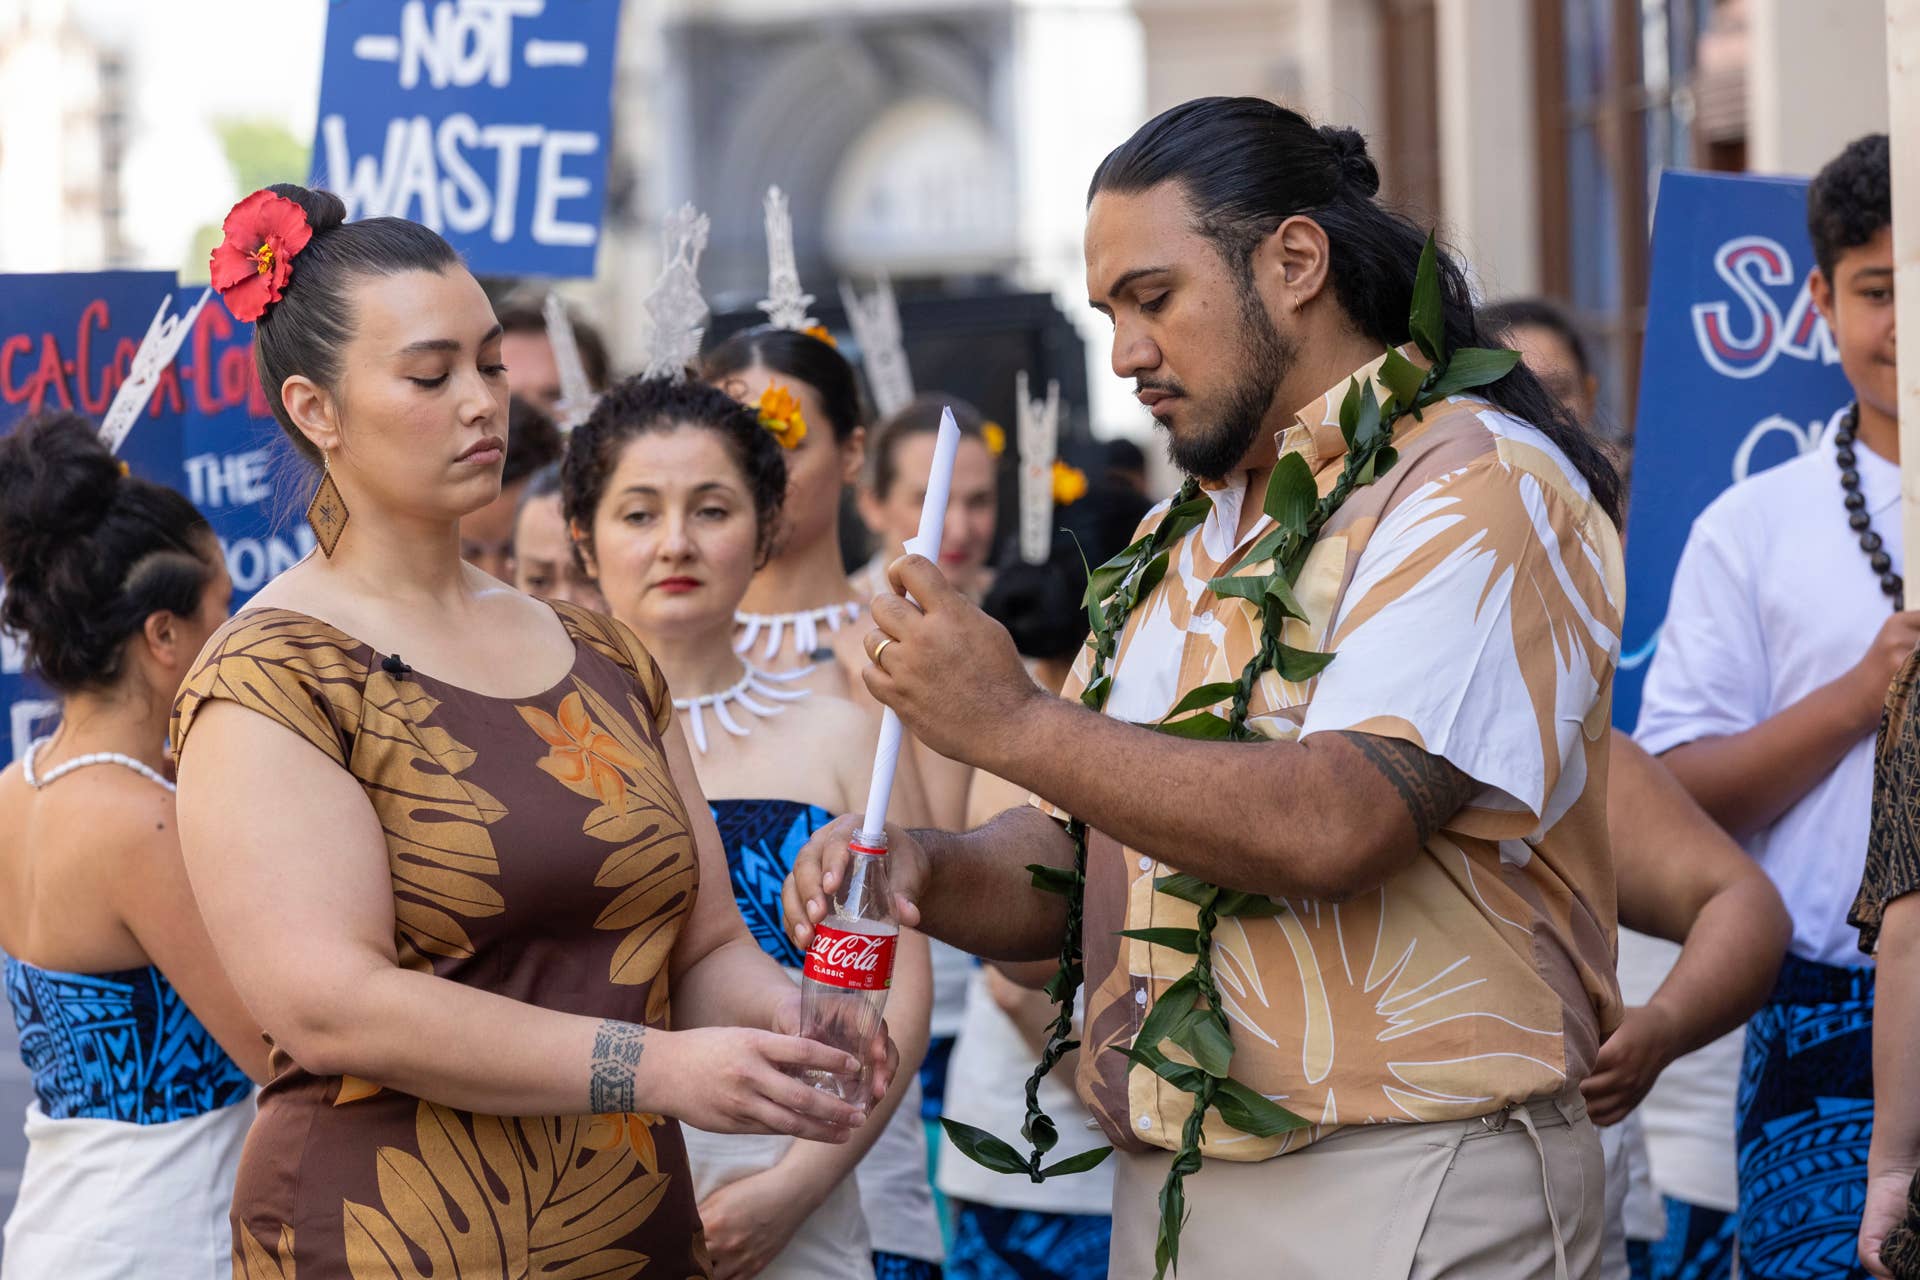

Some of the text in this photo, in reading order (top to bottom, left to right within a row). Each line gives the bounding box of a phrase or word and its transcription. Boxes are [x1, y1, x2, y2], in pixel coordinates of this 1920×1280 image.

[322, 112, 599, 246] WASTE
[184, 451, 274, 508] THE
[813, 964, 845, 979] CLASSIC
